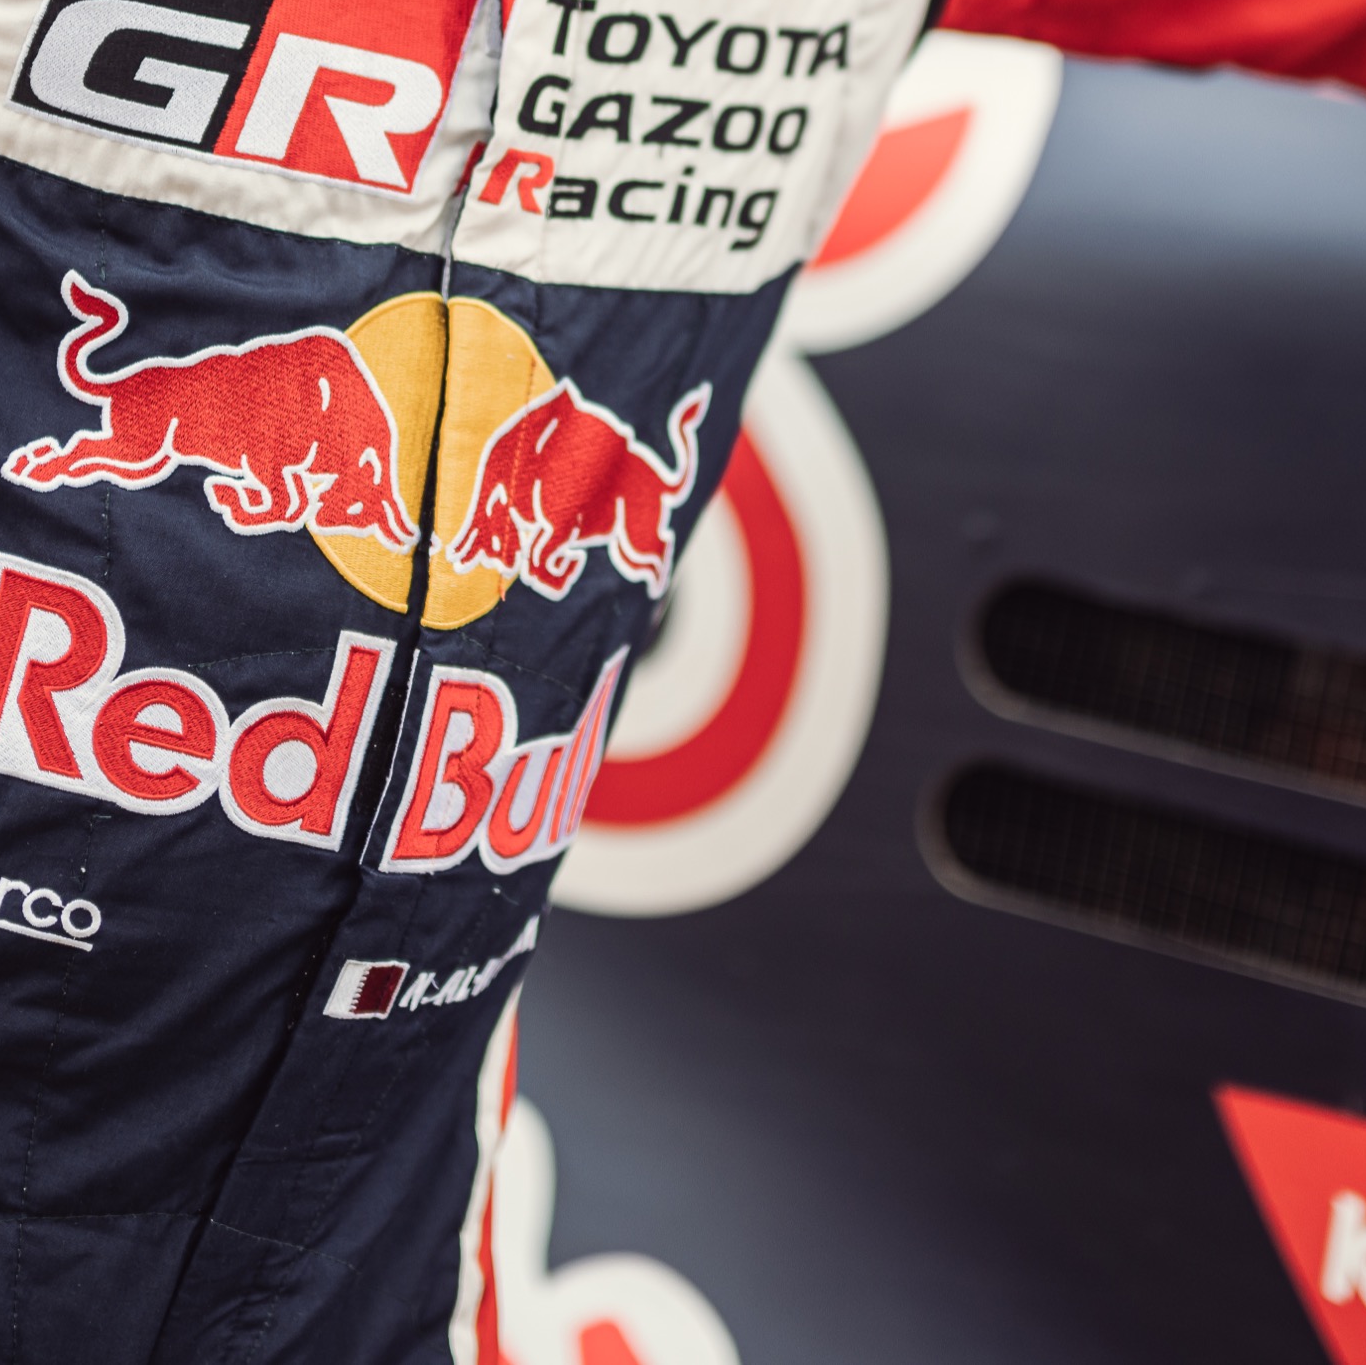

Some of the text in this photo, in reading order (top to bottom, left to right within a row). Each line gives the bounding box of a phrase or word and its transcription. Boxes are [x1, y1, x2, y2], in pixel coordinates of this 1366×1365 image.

[518, 74, 808, 155] GAZOO
[477, 147, 779, 251] Racing
[384, 645, 629, 868] Bull
